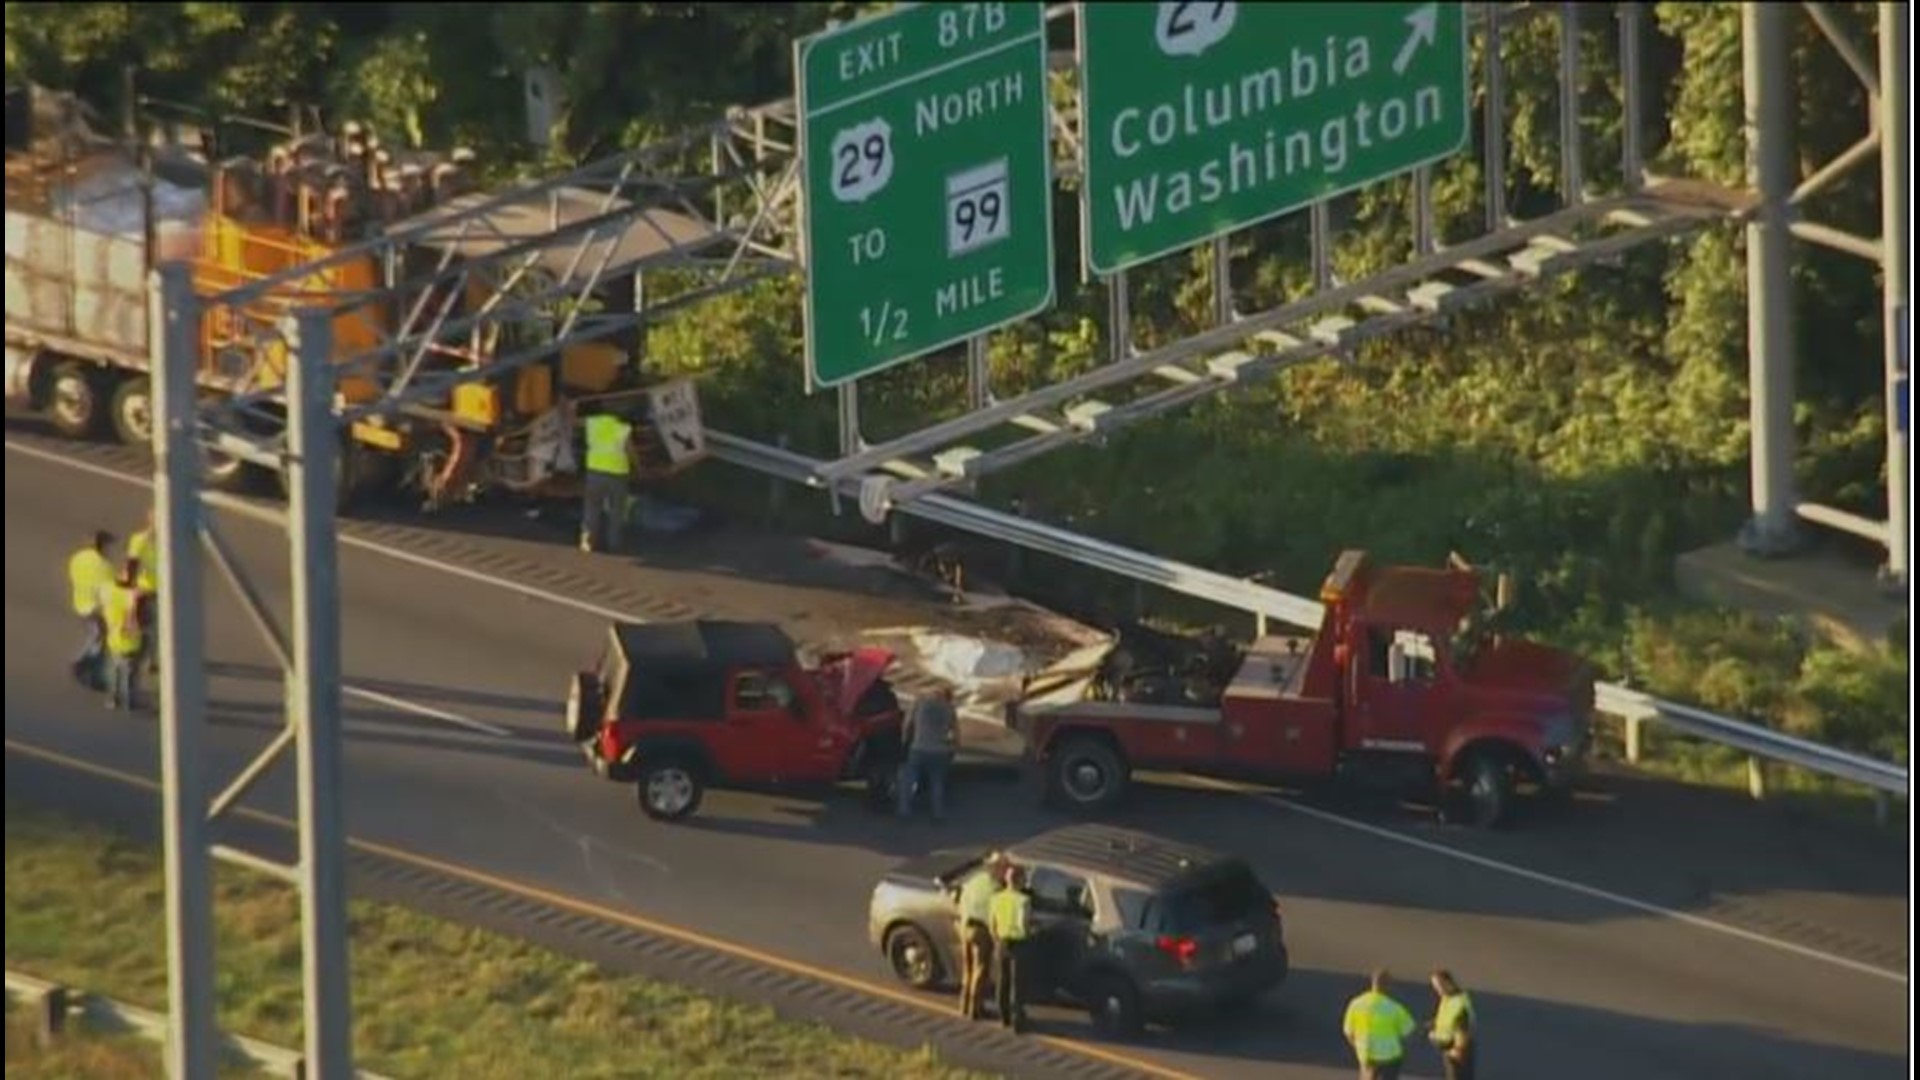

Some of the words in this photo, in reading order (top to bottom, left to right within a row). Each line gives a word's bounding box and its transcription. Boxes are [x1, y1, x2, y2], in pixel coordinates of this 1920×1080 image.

[839, 33, 901, 80] EXIT
[939, 3, 1005, 47] 87B
[915, 73, 1023, 136] NORTH
[1111, 36, 1371, 157] Columbia
[839, 134, 885, 189] 29
[1114, 85, 1441, 231] Washington
[850, 228, 886, 265] TO
[955, 191, 1000, 243] 99
[860, 301, 909, 347] 1/2
[935, 267, 1004, 318] MILE
